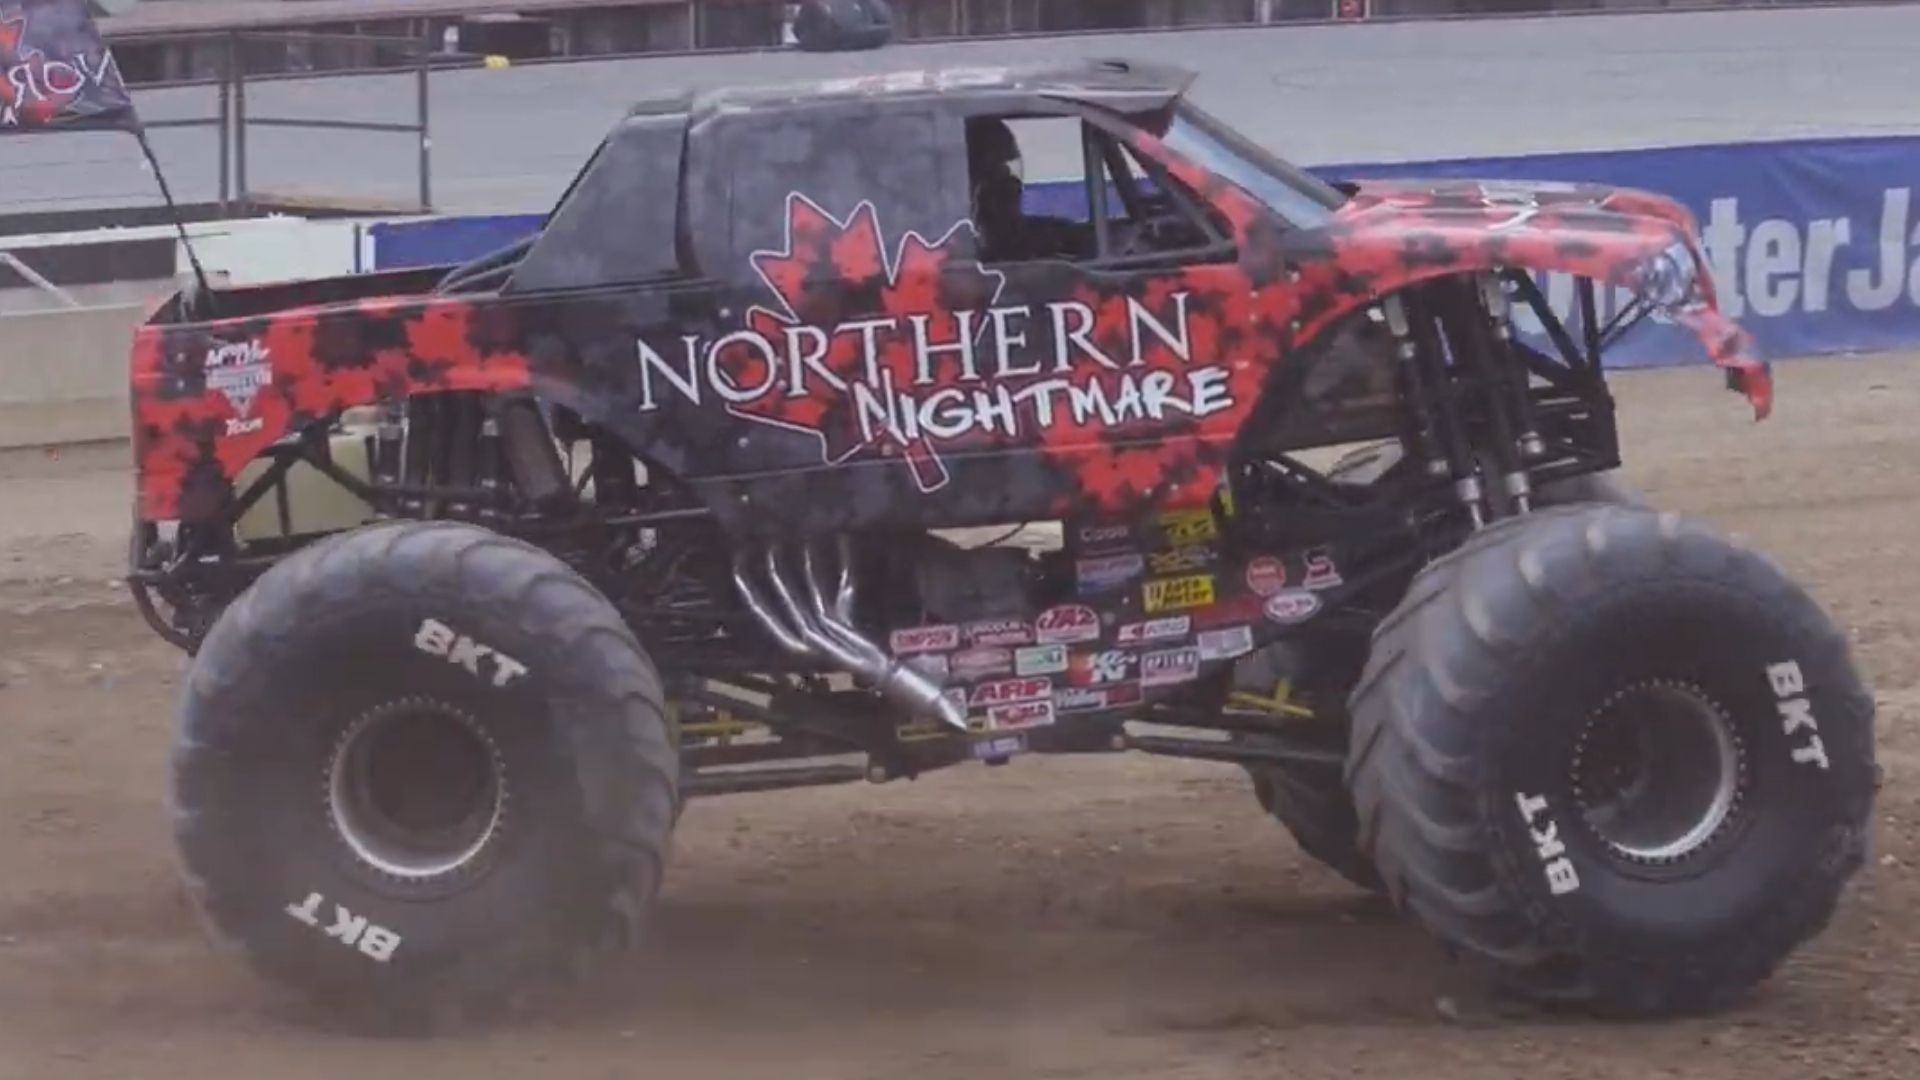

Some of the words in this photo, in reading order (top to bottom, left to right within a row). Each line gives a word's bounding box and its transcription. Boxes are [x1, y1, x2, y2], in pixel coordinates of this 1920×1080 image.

[637, 291, 1192, 411] NORTHERN
[853, 365, 1234, 446] NIGHTMARE
[414, 619, 527, 686] BKT
[971, 680, 1050, 703] ARP
[1766, 660, 1829, 769] BKT
[1515, 792, 1580, 894] BKT
[285, 892, 400, 962] BKT
